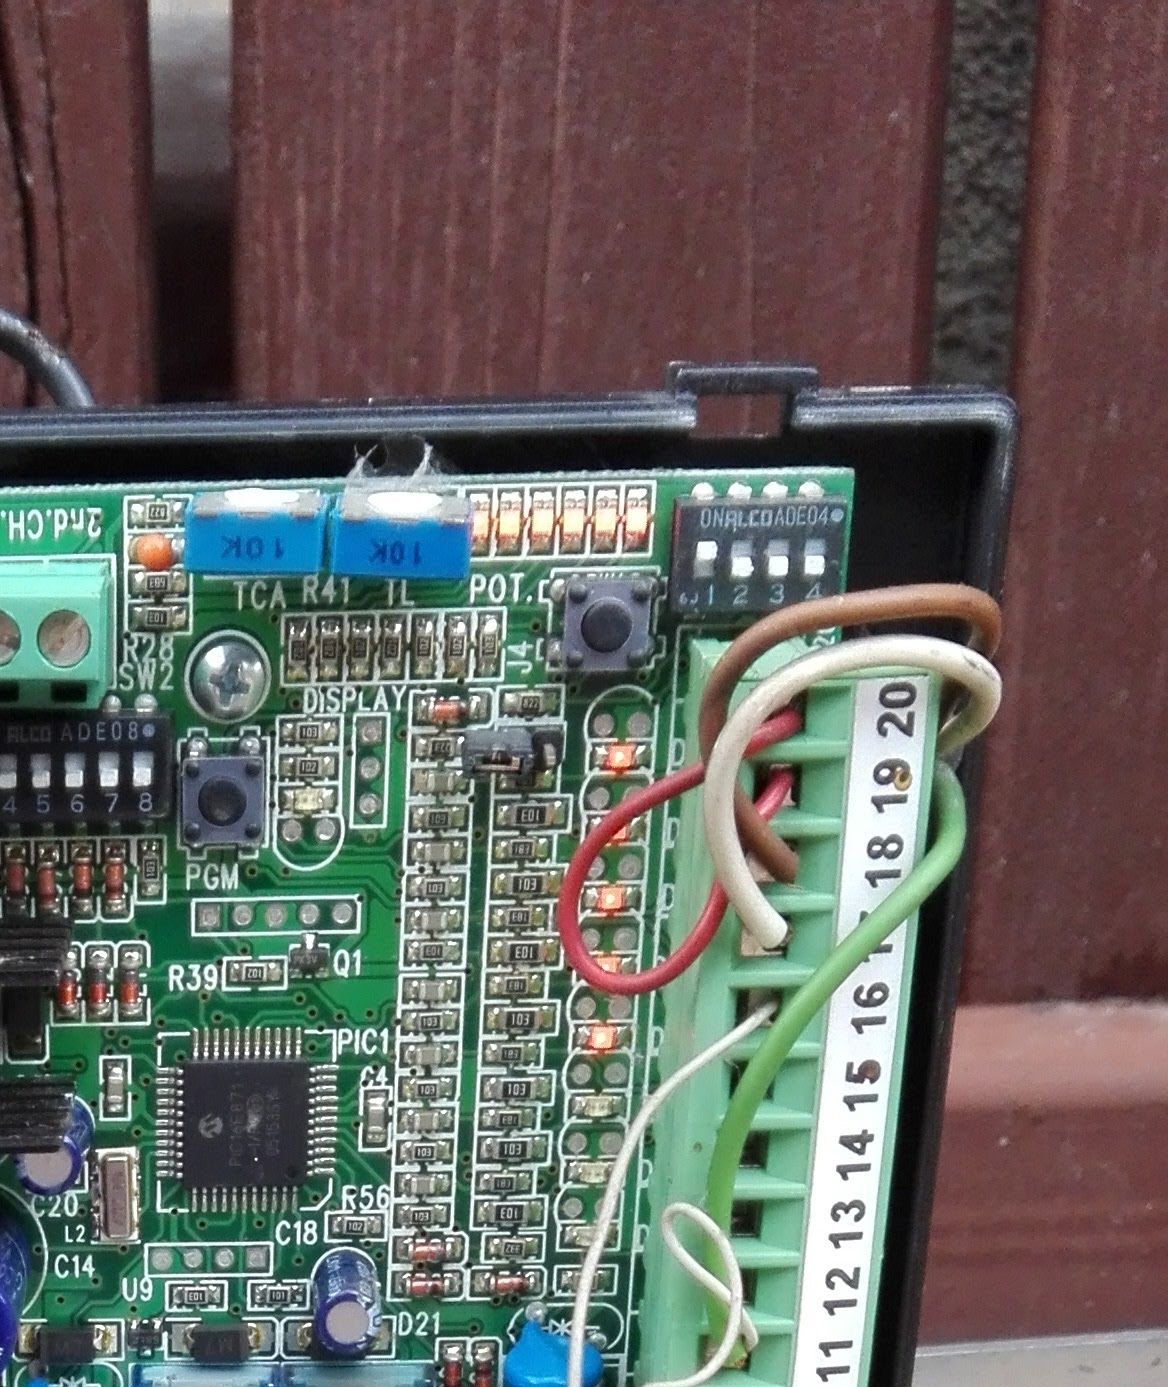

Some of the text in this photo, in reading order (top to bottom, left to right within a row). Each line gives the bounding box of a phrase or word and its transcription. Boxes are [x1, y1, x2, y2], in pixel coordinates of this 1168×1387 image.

[233, 579, 286, 610] TCA
[302, 575, 350, 603] R41
[470, 573, 532, 603] POT.
[733, 585, 749, 605] 2
[769, 584, 785, 604] 3
[123, 637, 174, 661] R28
[119, 663, 174, 690] SW2
[302, 686, 407, 713] DISPLAY
[876, 682, 917, 738] 20
[871, 758, 912, 814] 19
[2, 797, 17, 814] 4
[36, 794, 50, 812] 5
[70, 794, 84, 812] 6
[104, 793, 119, 812] 7
[139, 792, 153, 811] 8
[864, 834, 905, 889] 18
[186, 864, 240, 890] PGM
[333, 950, 361, 977] Q1
[168, 964, 218, 991] R39
[851, 981, 890, 1035] 16
[338, 1028, 389, 1055] PIC1
[842, 1059, 881, 1112] 15
[836, 1129, 874, 1181] 14
[341, 1185, 390, 1211] R56
[64, 1225, 86, 1244] L2
[275, 1220, 318, 1246] C18
[828, 1199, 867, 1249] 13
[54, 1254, 95, 1279] C14
[122, 1277, 153, 1303] U9
[823, 1266, 861, 1316] 12
[397, 1311, 440, 1337] D21
[816, 1340, 853, 1382] 11
